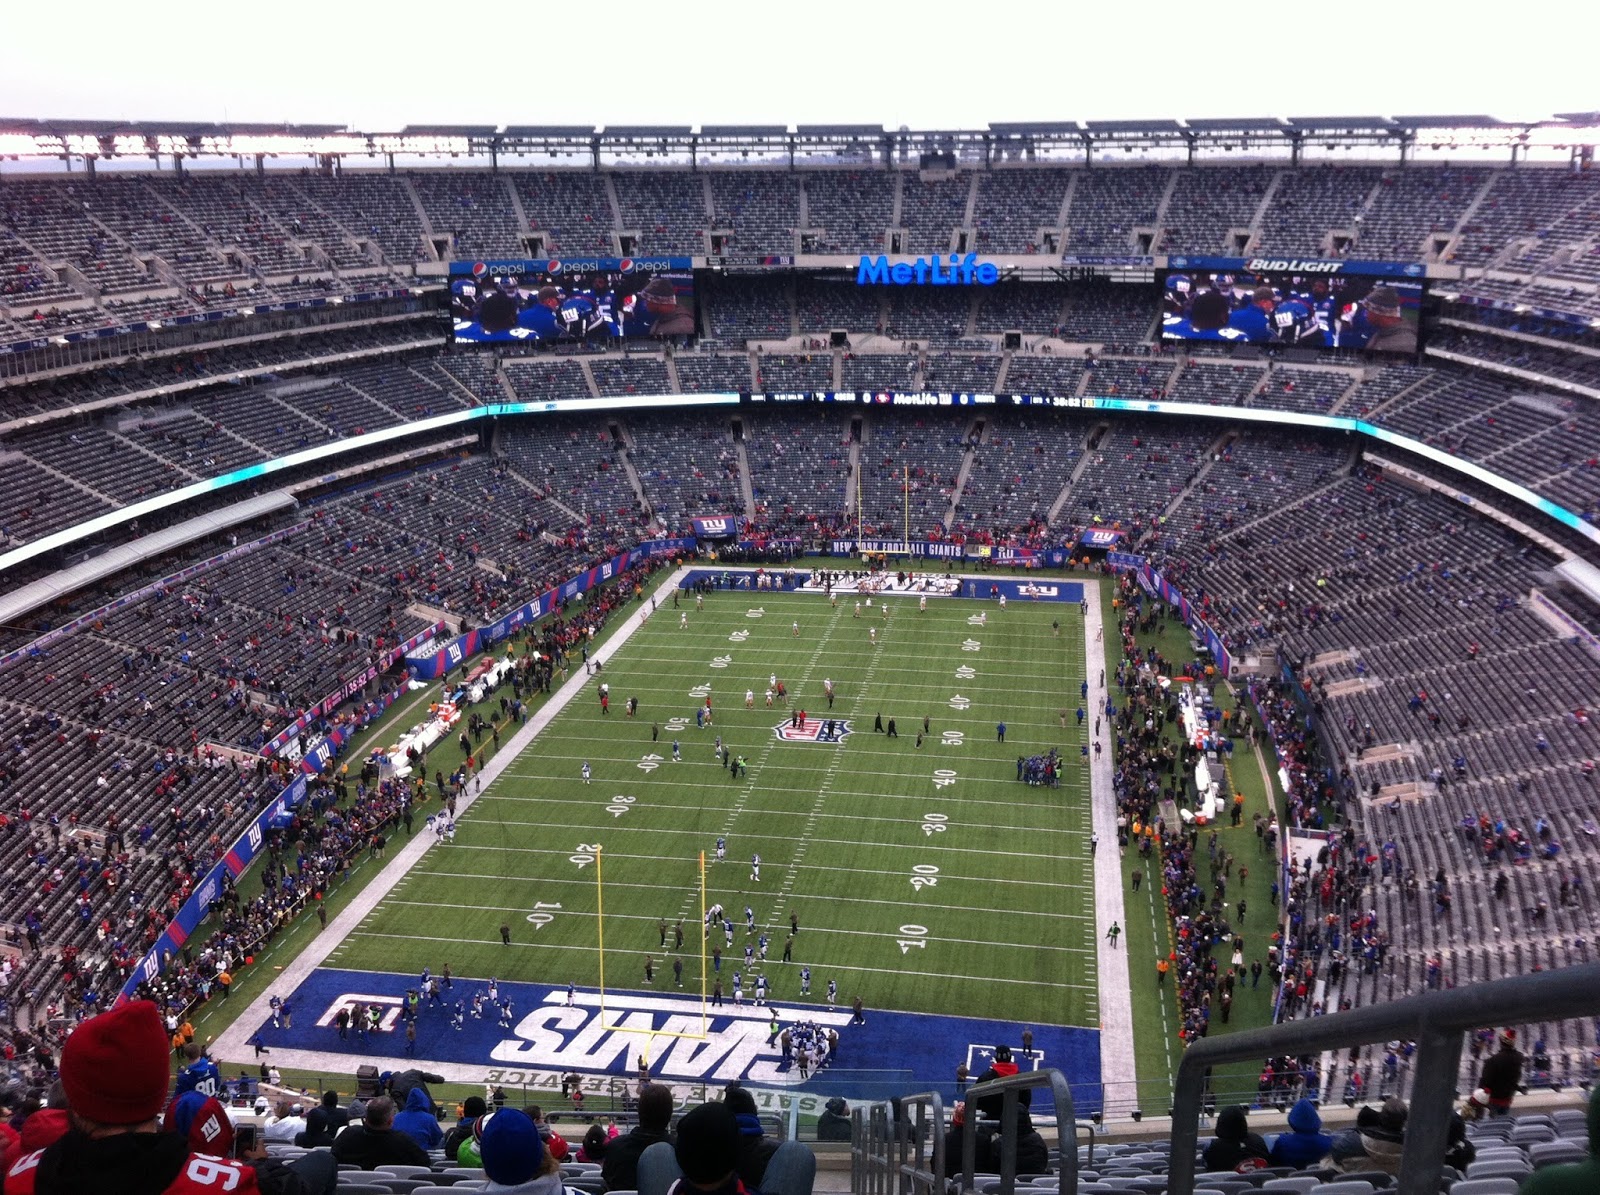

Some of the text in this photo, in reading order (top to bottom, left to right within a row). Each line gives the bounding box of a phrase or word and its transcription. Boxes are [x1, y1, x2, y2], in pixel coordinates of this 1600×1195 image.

[489, 263, 526, 277] pepsi
[563, 260, 599, 274] pepsi
[635, 260, 671, 274] pepsi
[857, 253, 998, 285] MetLife
[1249, 259, 1343, 272] BUD LIGHT
[894, 392, 938, 405] MetLife
[833, 541, 852, 552] NEW
[856, 541, 878, 552] YORK
[929, 543, 961, 556] GIANTS
[955, 666, 976, 679] 30
[949, 697, 970, 710] 40
[664, 717, 690, 731] 50
[941, 731, 964, 746] 50
[637, 753, 665, 769] 40
[934, 769, 957, 786] 40
[606, 795, 637, 813] 30
[922, 813, 949, 832] 30
[568, 843, 603, 863] 20
[910, 864, 939, 887] 20
[526, 901, 562, 923] 10
[897, 924, 928, 949] 10
[482, 1068, 628, 1094] SEVICE
[686, 1083, 818, 1111] SALTE
